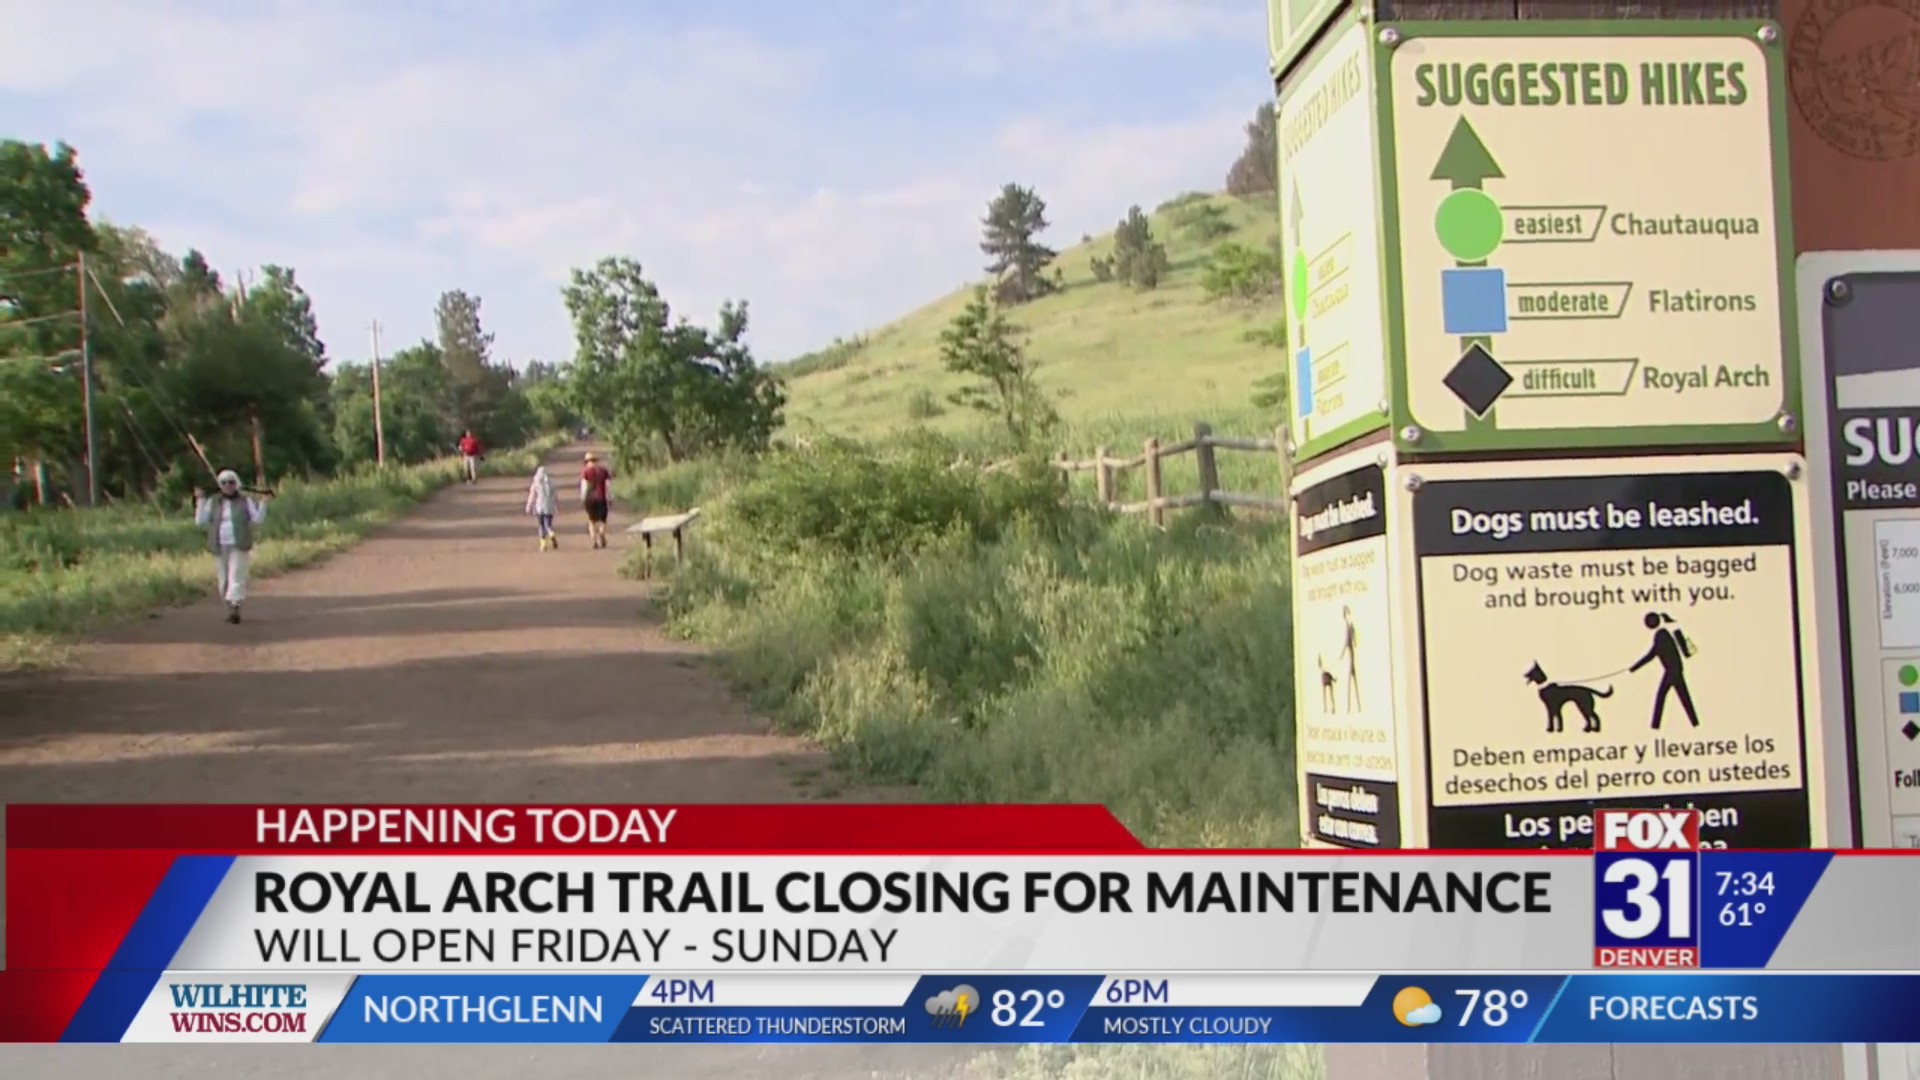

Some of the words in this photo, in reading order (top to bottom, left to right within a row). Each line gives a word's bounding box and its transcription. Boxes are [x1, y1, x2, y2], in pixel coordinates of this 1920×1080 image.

[1415, 62, 1629, 107] SUGGESTED
[1640, 62, 1748, 106] HIKES
[1514, 213, 1583, 235] easiest
[1611, 212, 1760, 239] Chautauqua
[1518, 291, 1609, 313] moderate
[1649, 289, 1757, 312] Flatirons
[1523, 368, 1596, 390] difficult
[1643, 365, 1708, 393] Royal
[1715, 365, 1770, 387] Arch
[1843, 416, 1920, 467] SU
[1846, 479, 1917, 500] Please
[1451, 508, 1522, 539] Dogs
[1531, 505, 1600, 531] must
[1606, 503, 1641, 528] be
[1649, 499, 1760, 528] leashed.
[1892, 546, 1919, 560] 7,000
[1453, 563, 1498, 585] Dog
[1506, 562, 1573, 580] waste
[1581, 560, 1635, 578] must
[1642, 556, 1668, 575] be
[1675, 552, 1757, 578] bagged
[1485, 589, 1527, 608] and
[1534, 585, 1624, 610] brought
[1632, 581, 1681, 603] with
[1689, 585, 1735, 606] you.
[1454, 747, 1525, 767] Deben
[1533, 744, 1627, 765] empacar
[1634, 745, 1648, 764] y
[1654, 738, 1738, 758] llevarse
[1745, 734, 1775, 754] los
[1445, 773, 1547, 796] desechos
[1556, 770, 1588, 790] del
[1597, 770, 1655, 792] perro
[1662, 766, 1700, 785] con
[1708, 760, 1791, 782] ustedes
[1504, 813, 1552, 838] Los
